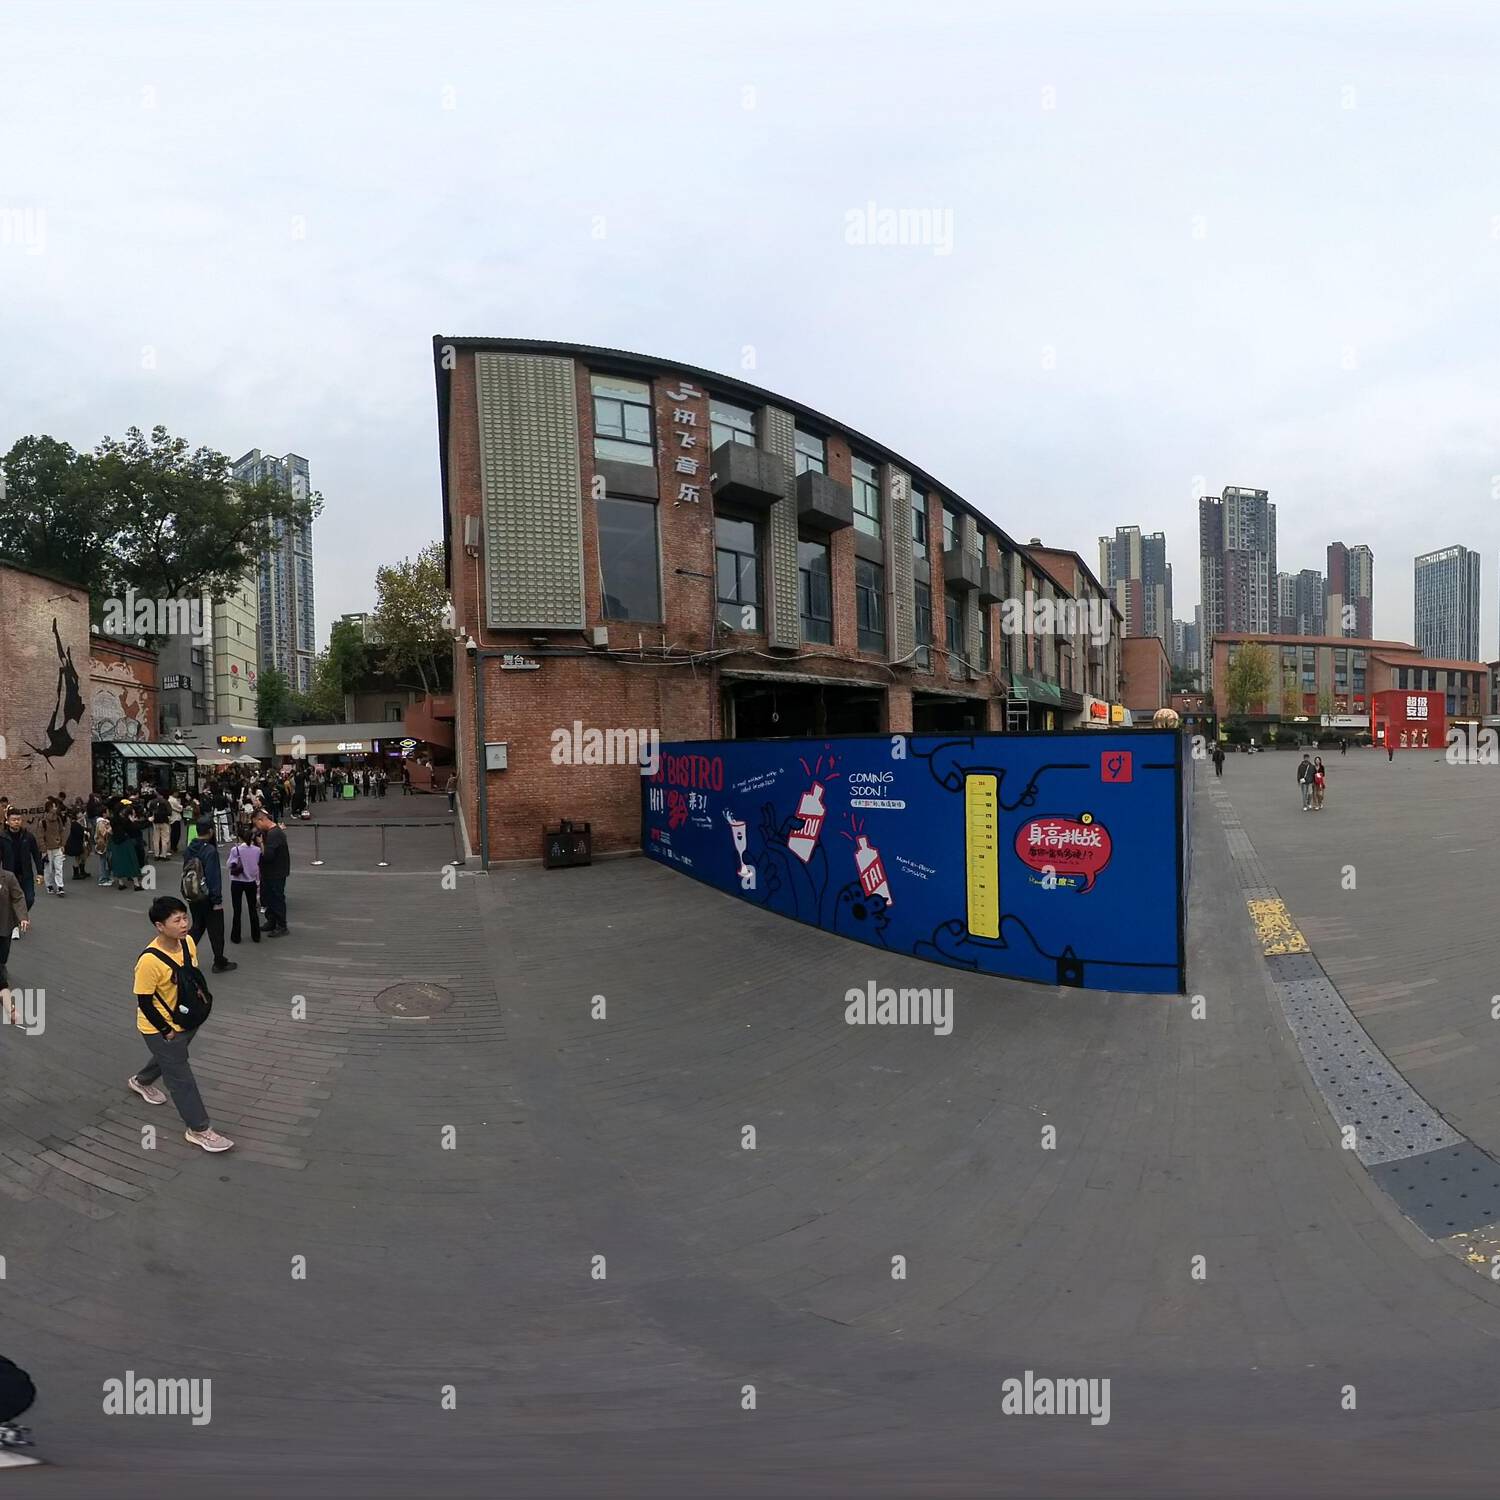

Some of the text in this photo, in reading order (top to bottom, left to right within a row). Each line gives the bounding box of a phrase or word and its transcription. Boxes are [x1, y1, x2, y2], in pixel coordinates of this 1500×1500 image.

[849, 772, 894, 783] COMING
[650, 787, 664, 814] Hi!
[1028, 823, 1102, 848] 身高挑战
[862, 864, 883, 892] TAI
